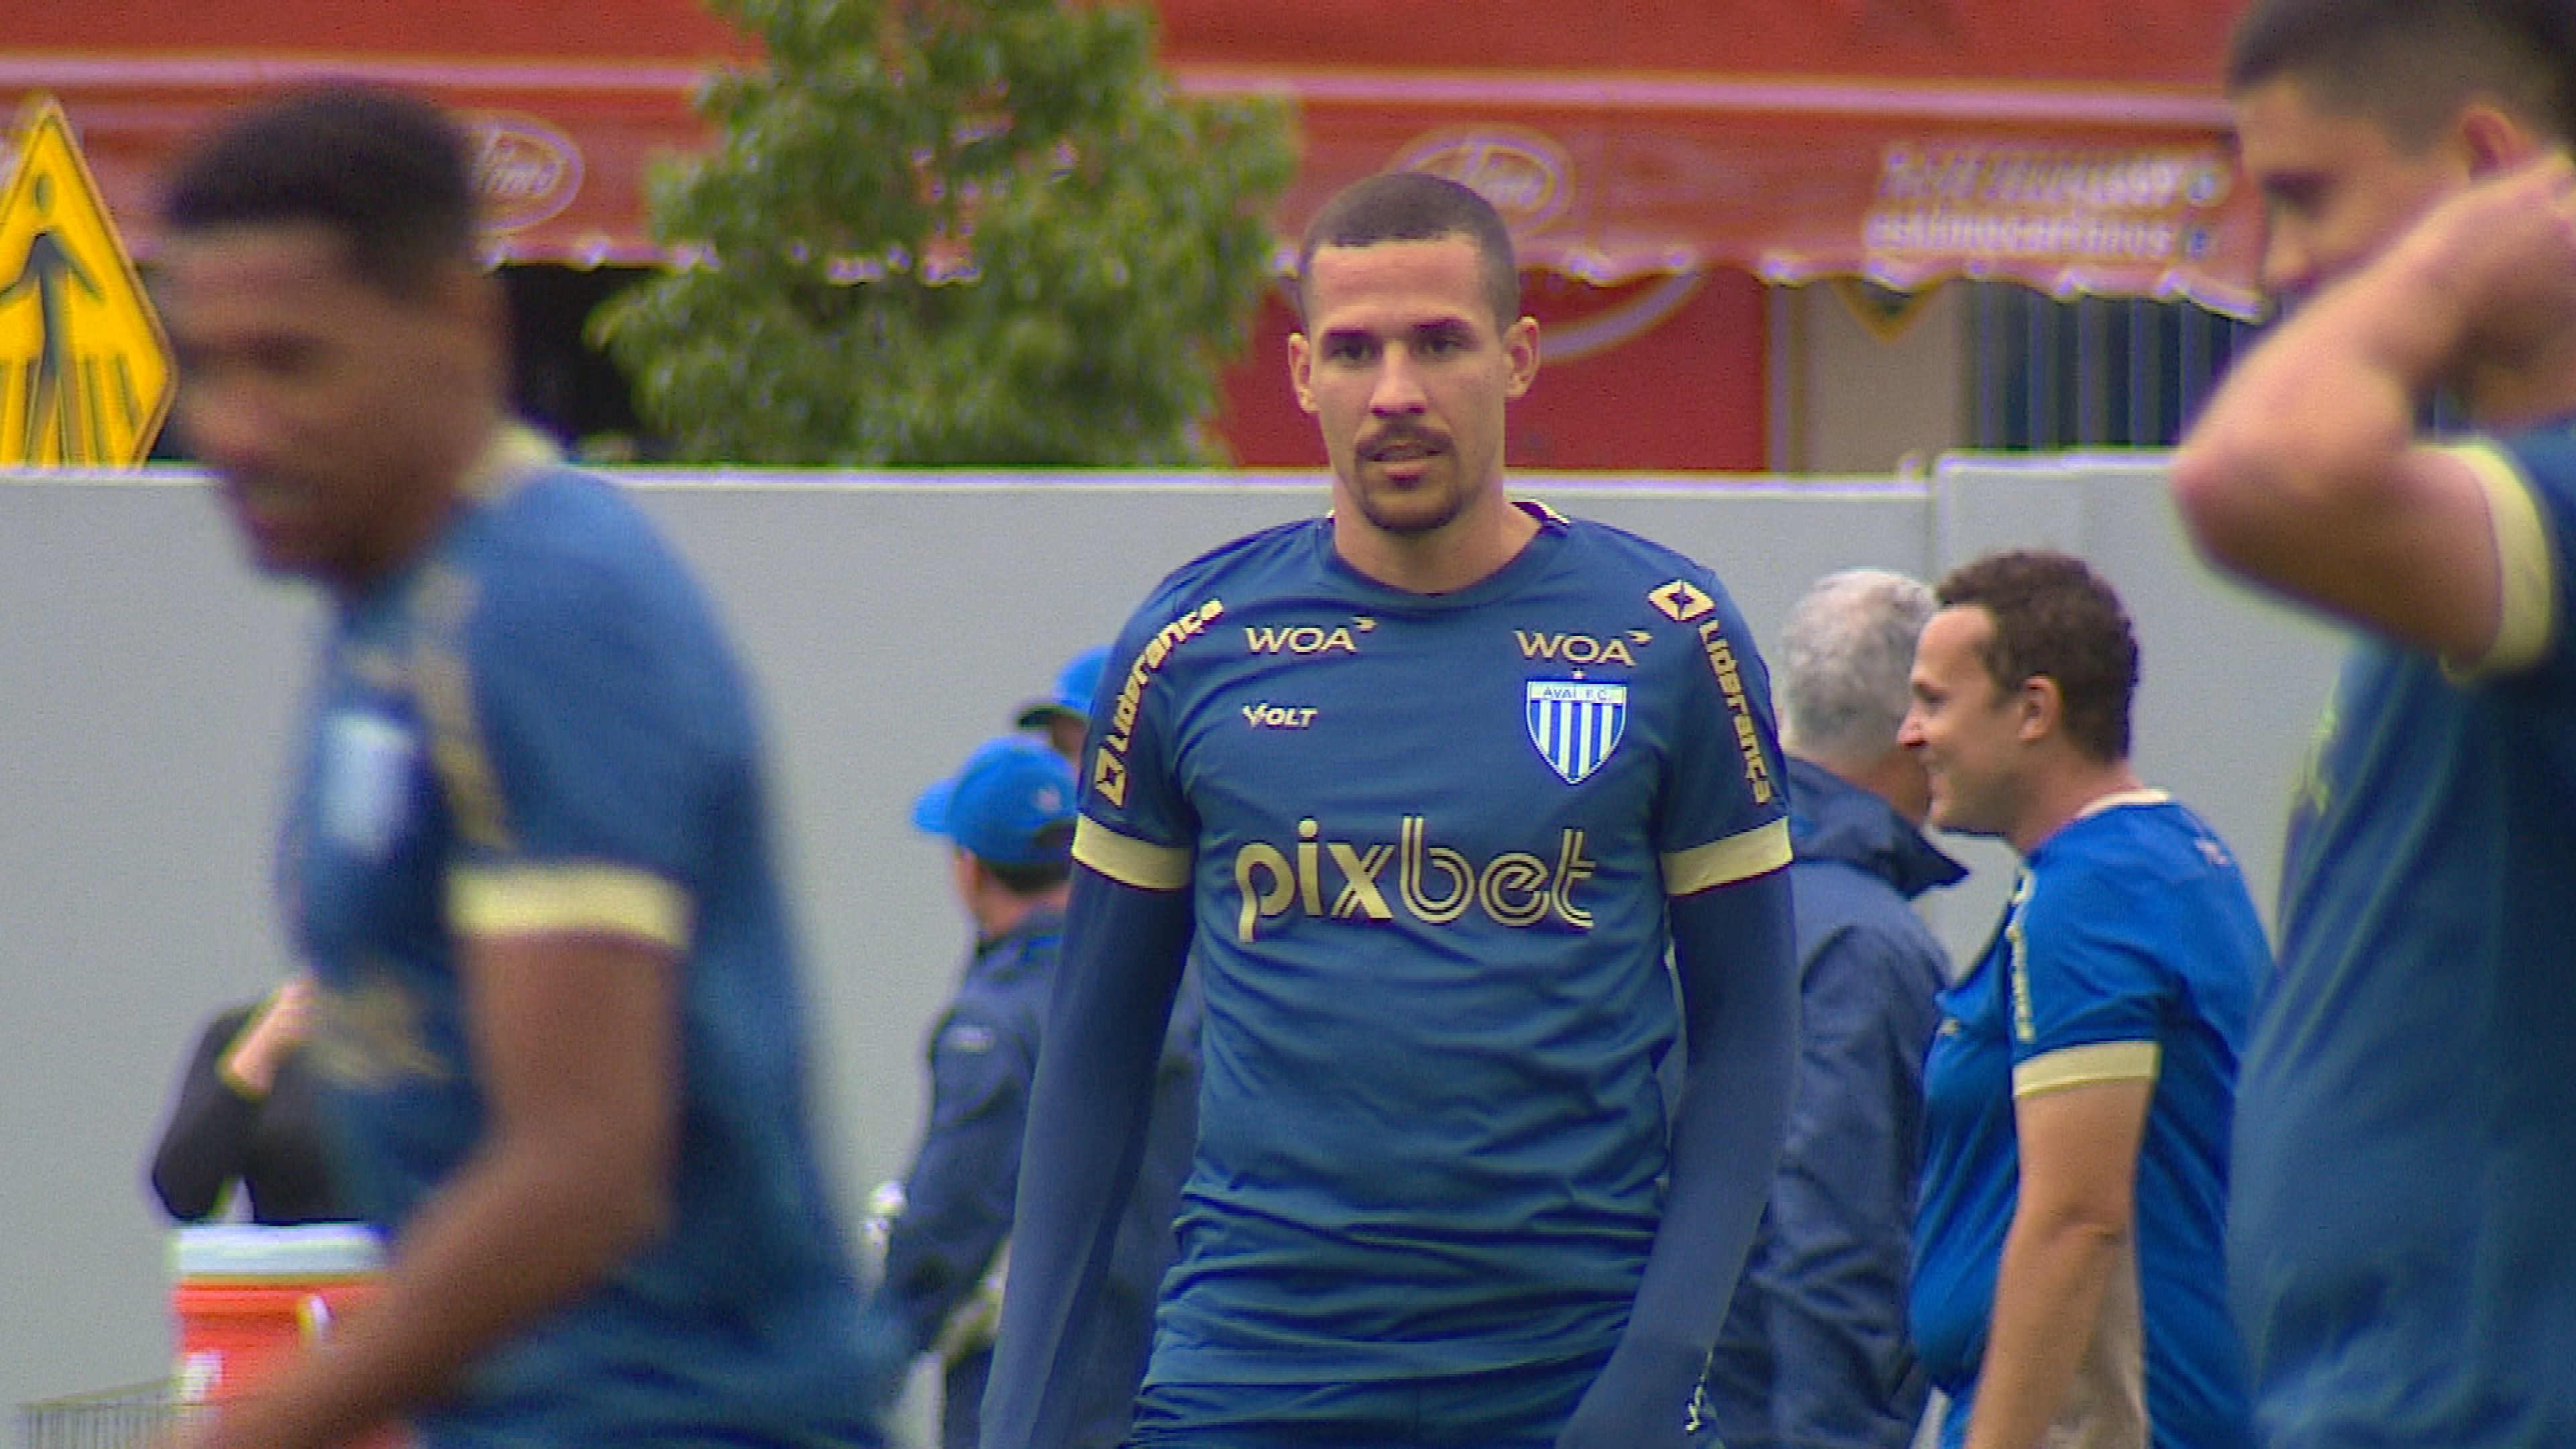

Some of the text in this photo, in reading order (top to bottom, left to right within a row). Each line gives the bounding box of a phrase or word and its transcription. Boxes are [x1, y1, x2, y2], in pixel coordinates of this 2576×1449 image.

[1243, 627, 1357, 653] WOA
[1513, 630, 1638, 666] WOA
[1234, 816, 1596, 943] pixbet
